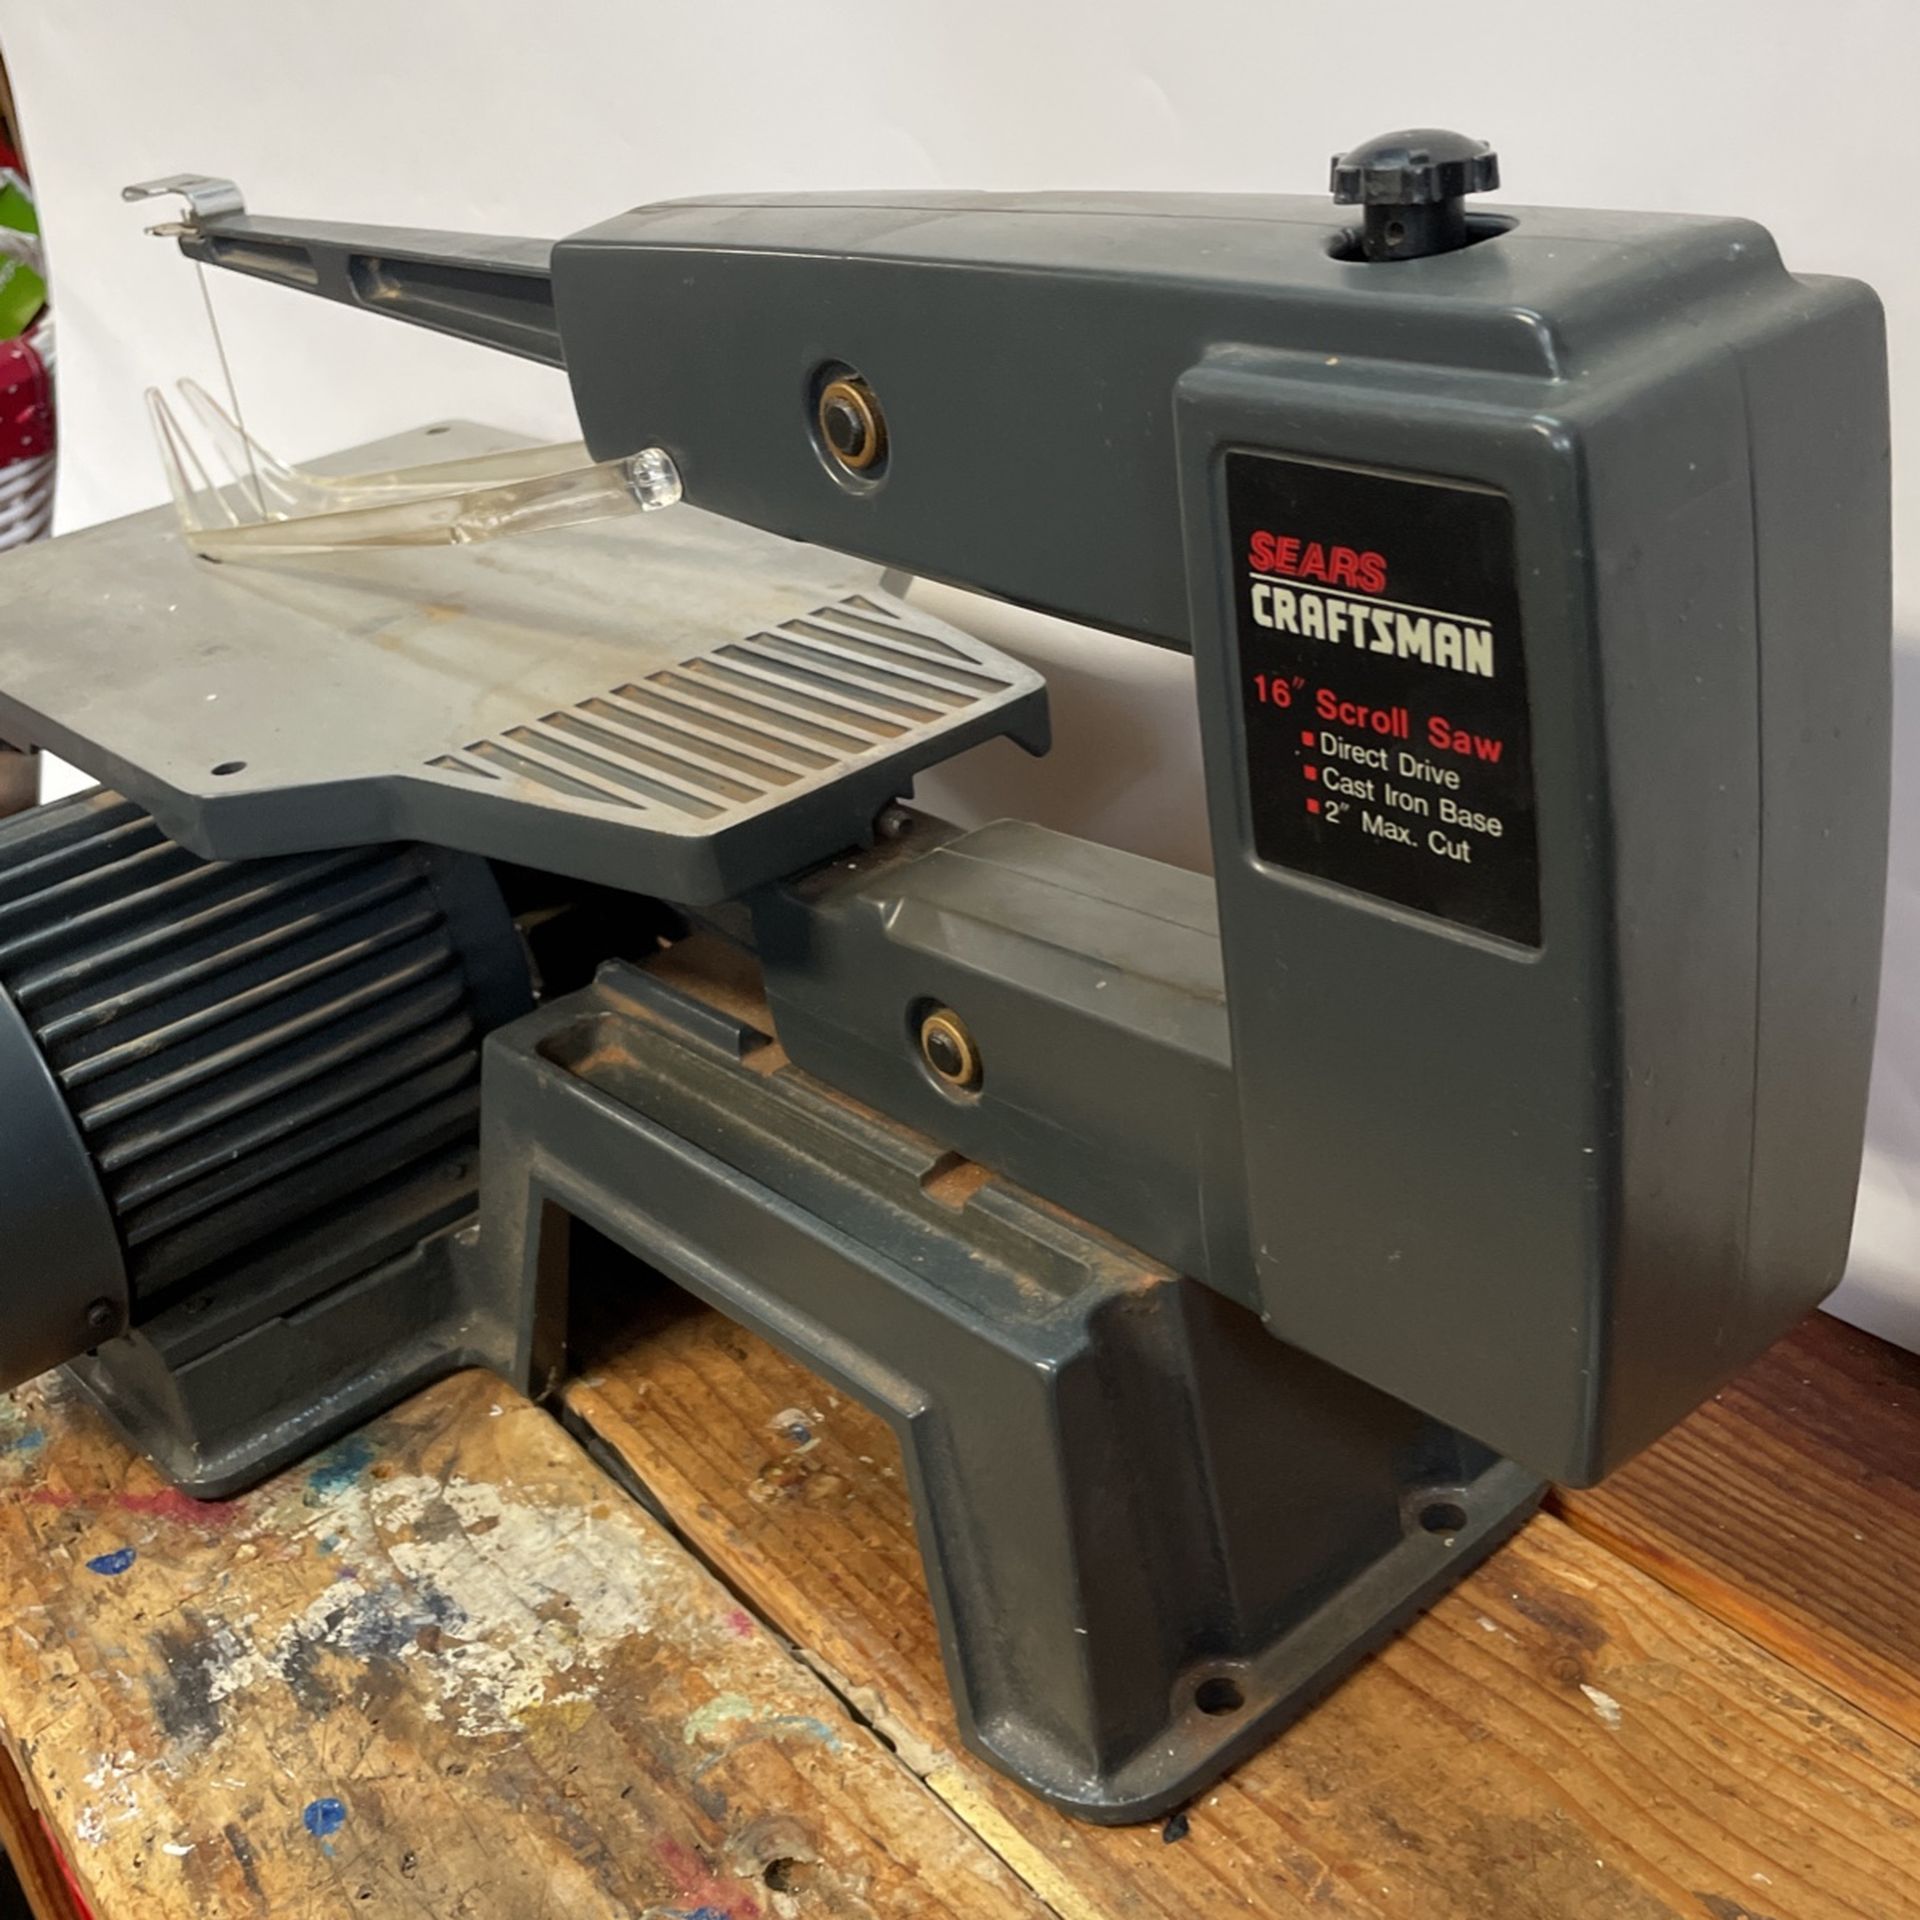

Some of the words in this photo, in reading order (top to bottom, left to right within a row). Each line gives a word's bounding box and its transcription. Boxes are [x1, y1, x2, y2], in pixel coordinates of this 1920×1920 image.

[1249, 531, 1387, 593] SEARS
[1250, 583, 1494, 678] CRAFTSMAN
[1316, 688, 1409, 739] Scroll
[1427, 715, 1503, 763] Saw
[1320, 731, 1389, 771] Direct
[1398, 752, 1460, 790] Drive
[1322, 766, 1375, 802] Cast
[1384, 783, 1429, 817] Iron
[1439, 797, 1503, 837] Base
[1362, 810, 1418, 847] Max.
[1428, 830, 1471, 864] Cut
